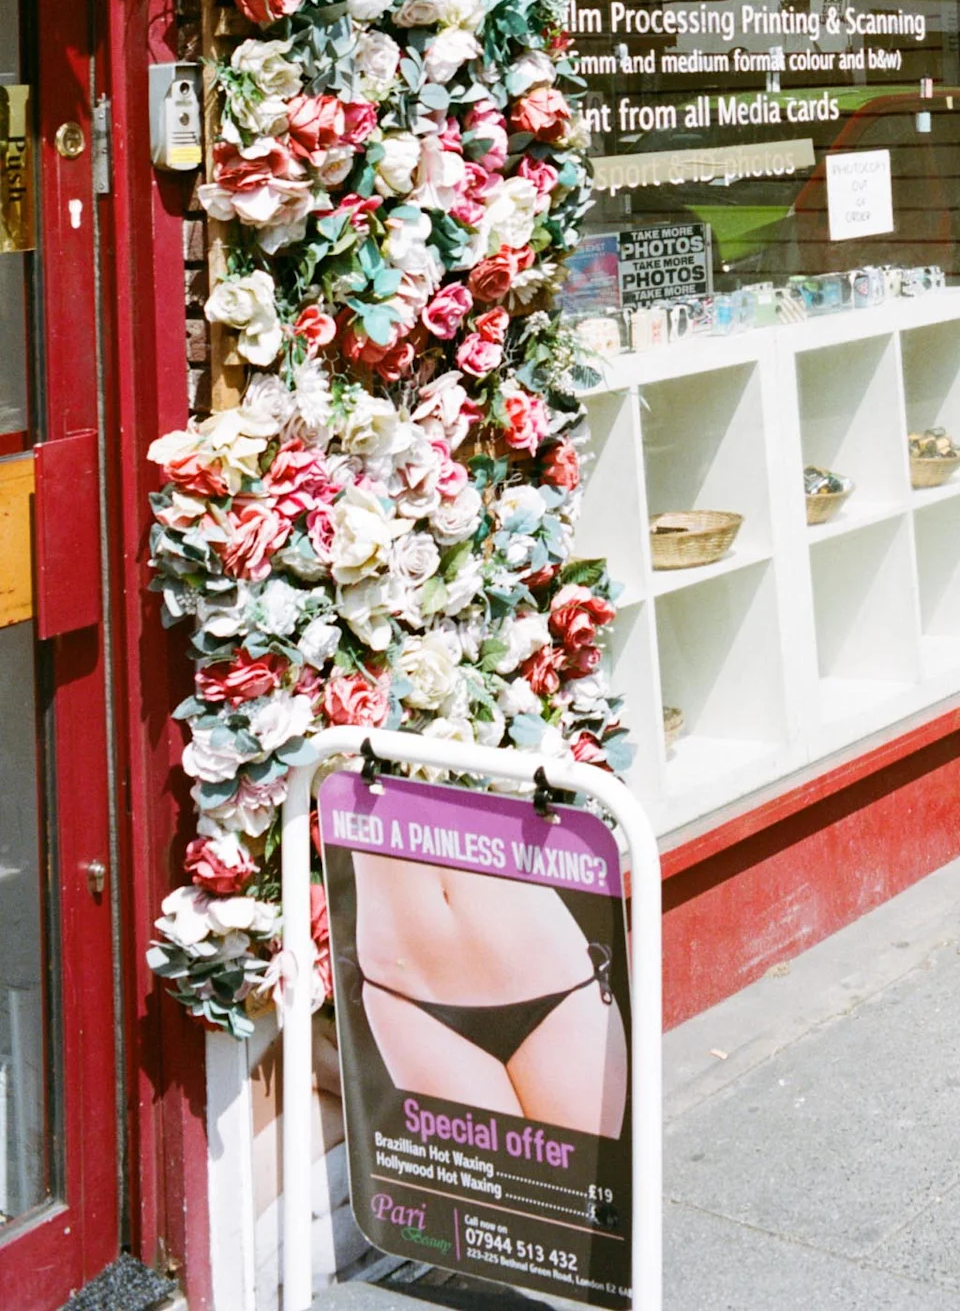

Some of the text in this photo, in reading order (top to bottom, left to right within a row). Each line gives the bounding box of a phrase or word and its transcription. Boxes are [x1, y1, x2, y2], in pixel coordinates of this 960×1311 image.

[611, 1, 735, 41] Processing
[741, 5, 820, 41] Printing
[826, 6, 840, 35] &
[846, 6, 926, 41] Scanning
[621, 49, 655, 74] and
[661, 49, 729, 74] medium
[733, 48, 785, 72] format
[789, 48, 835, 71] colour
[839, 48, 865, 70] and
[868, 48, 902, 71] b&w)
[619, 97, 677, 131] from
[685, 96, 710, 128] all
[718, 93, 782, 126] Media
[786, 91, 840, 122] cards
[8, 136, 27, 203] Push
[723, 149, 796, 188] photos
[621, 235, 705, 260] PHOTOS
[631, 226, 694, 241] TAKE MORE
[622, 265, 706, 290] PHOTOS
[632, 256, 695, 272] TAKE MORE
[634, 284, 696, 301] TAKE MORE
[332, 809, 608, 888] NEED A PAINLESS WAXING?
[403, 1097, 576, 1169] Special offer
[374, 1131, 613, 1203] Brazillian Hot Waxing £19
[375, 1152, 502, 1200] Hollywood Hot Waxing
[370, 1193, 427, 1231] Pari
[464, 1214, 508, 1235] Call now on
[401, 1226, 452, 1256] Beauty
[465, 1227, 578, 1272] 07944 513 432
[466, 1247, 499, 1265] 223-225
[500, 1256, 529, 1273] Bethnal
[529, 1262, 552, 1278] Green
[552, 1266, 575, 1284] Road,
[575, 1275, 605, 1292] London
[606, 1282, 617, 1294] E2
